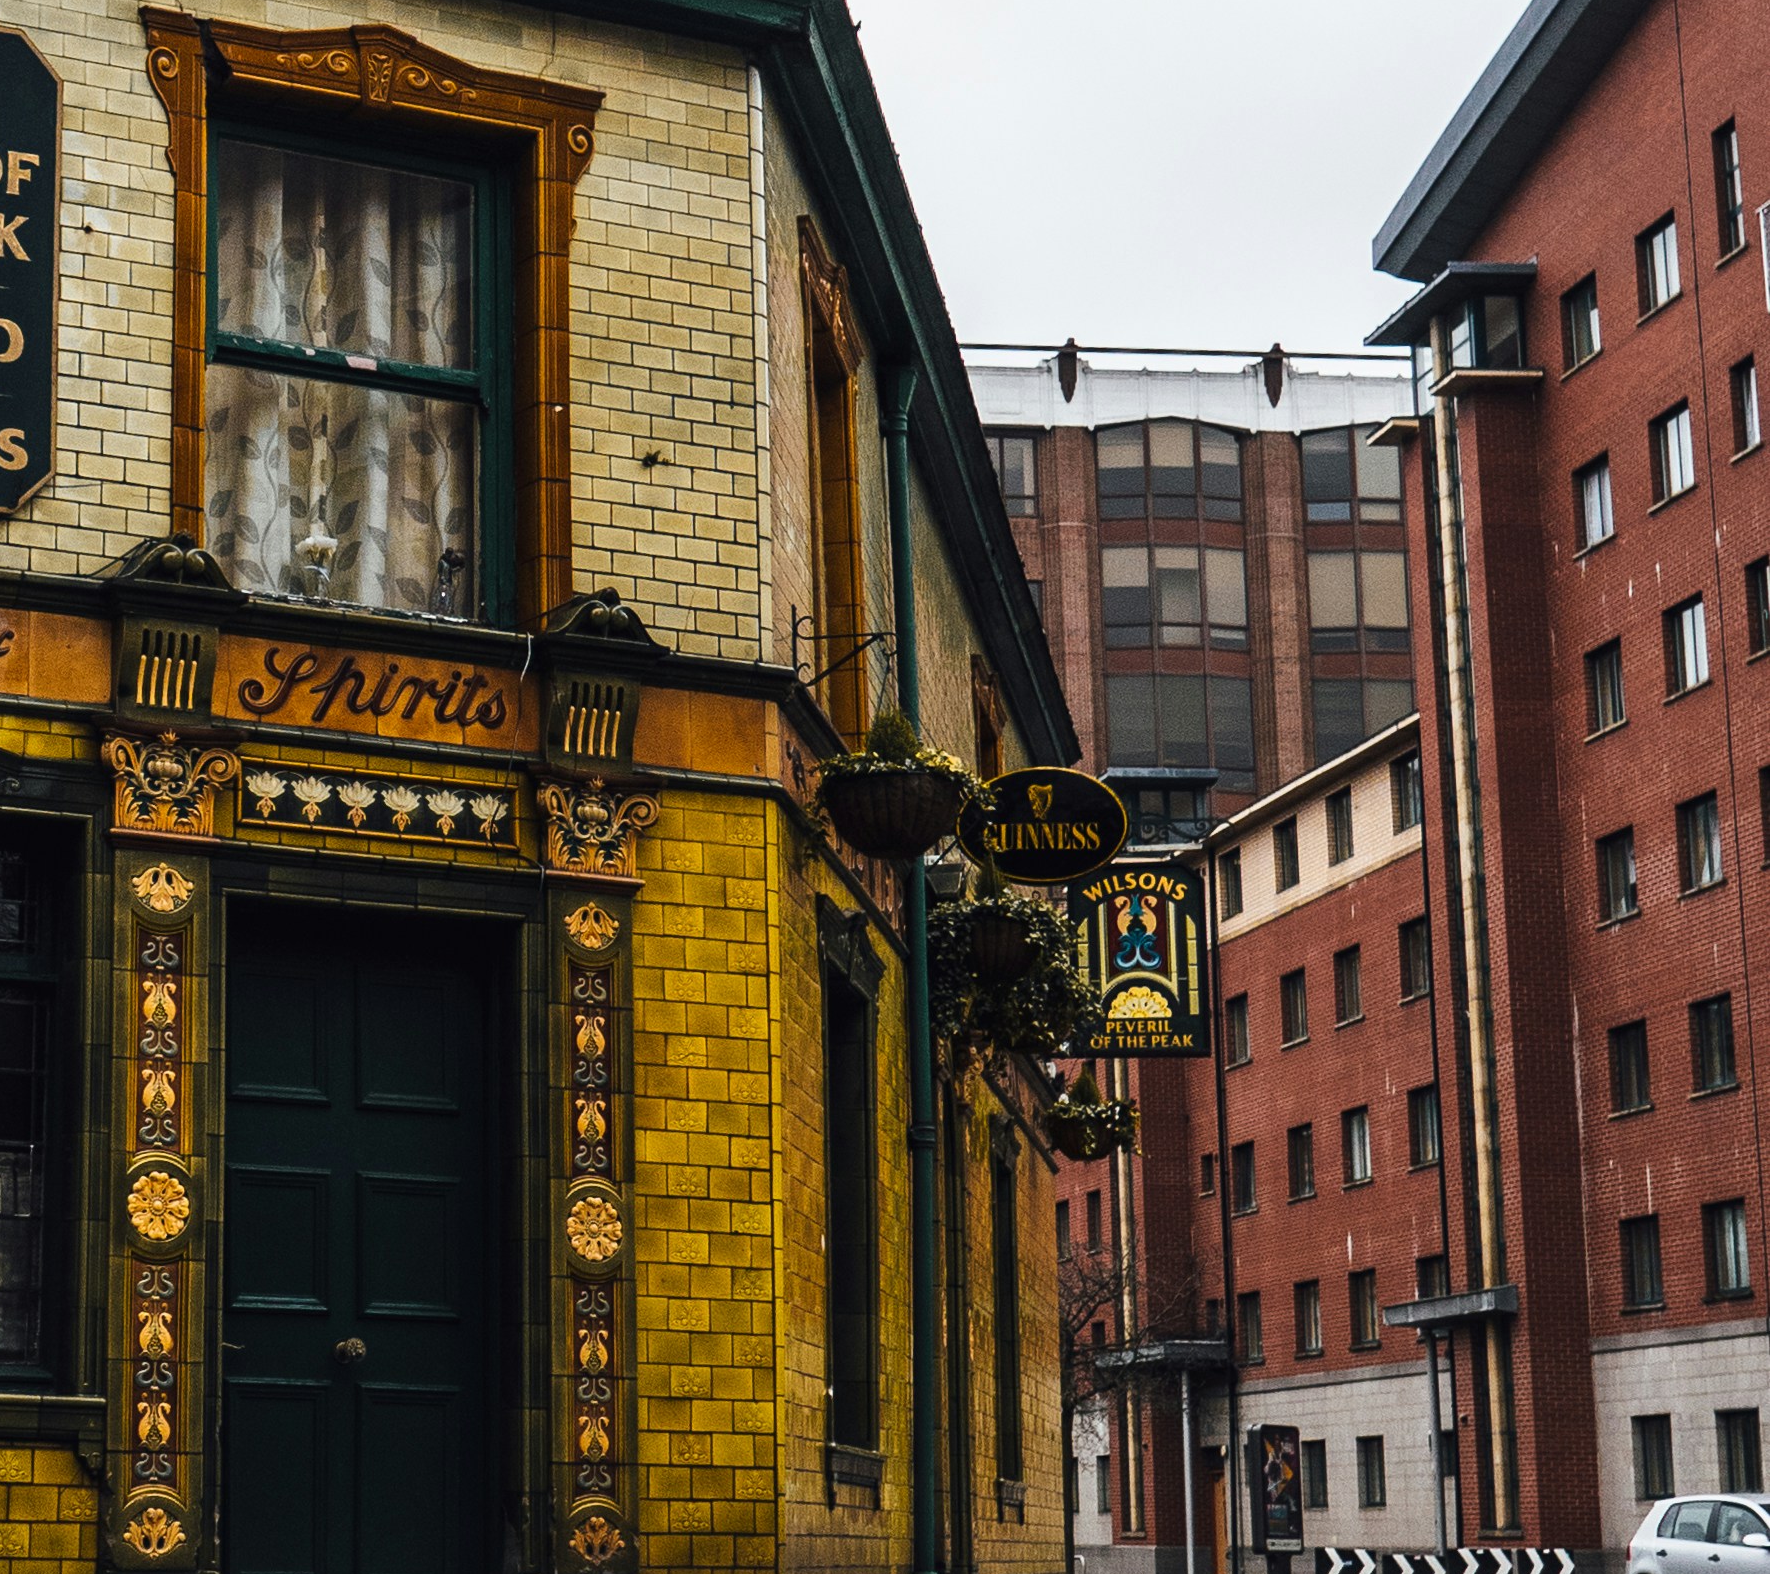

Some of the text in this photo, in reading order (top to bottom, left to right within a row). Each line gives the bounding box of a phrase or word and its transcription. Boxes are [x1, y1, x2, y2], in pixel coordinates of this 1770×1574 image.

[239, 645, 508, 730] Spirits
[983, 823, 1100, 851] GUINNESS
[1082, 872, 1188, 902] WILSONS
[1106, 1020, 1173, 1033] PEVERIL
[1090, 1034, 1194, 1049] OF THE PEAK
